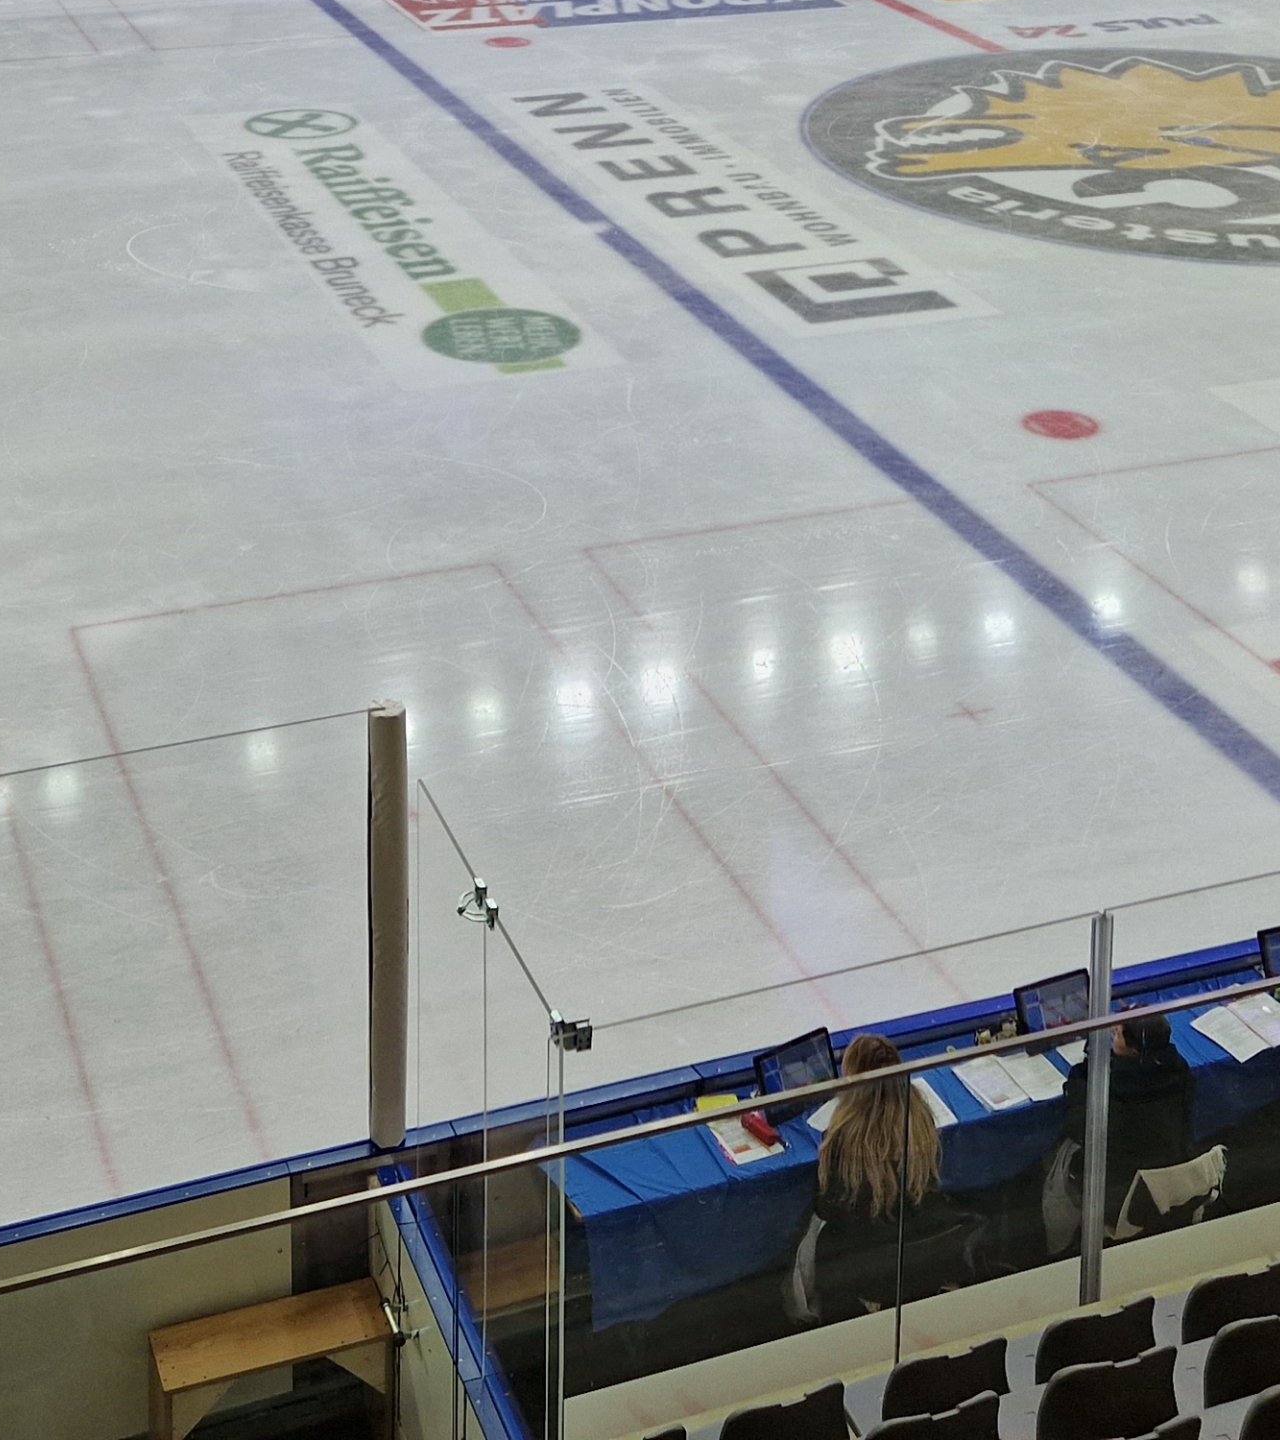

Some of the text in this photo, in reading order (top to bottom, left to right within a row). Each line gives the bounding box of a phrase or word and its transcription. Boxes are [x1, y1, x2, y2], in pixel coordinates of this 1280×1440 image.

[1090, 13, 1222, 34] PULS
[221, 150, 405, 328] Raiffeisenkasse Bruneck
[297, 142, 463, 280] Raiffeisen
[512, 92, 806, 258] PRENN
[601, 87, 858, 247] WOHNBAU IMMOBILIEN
